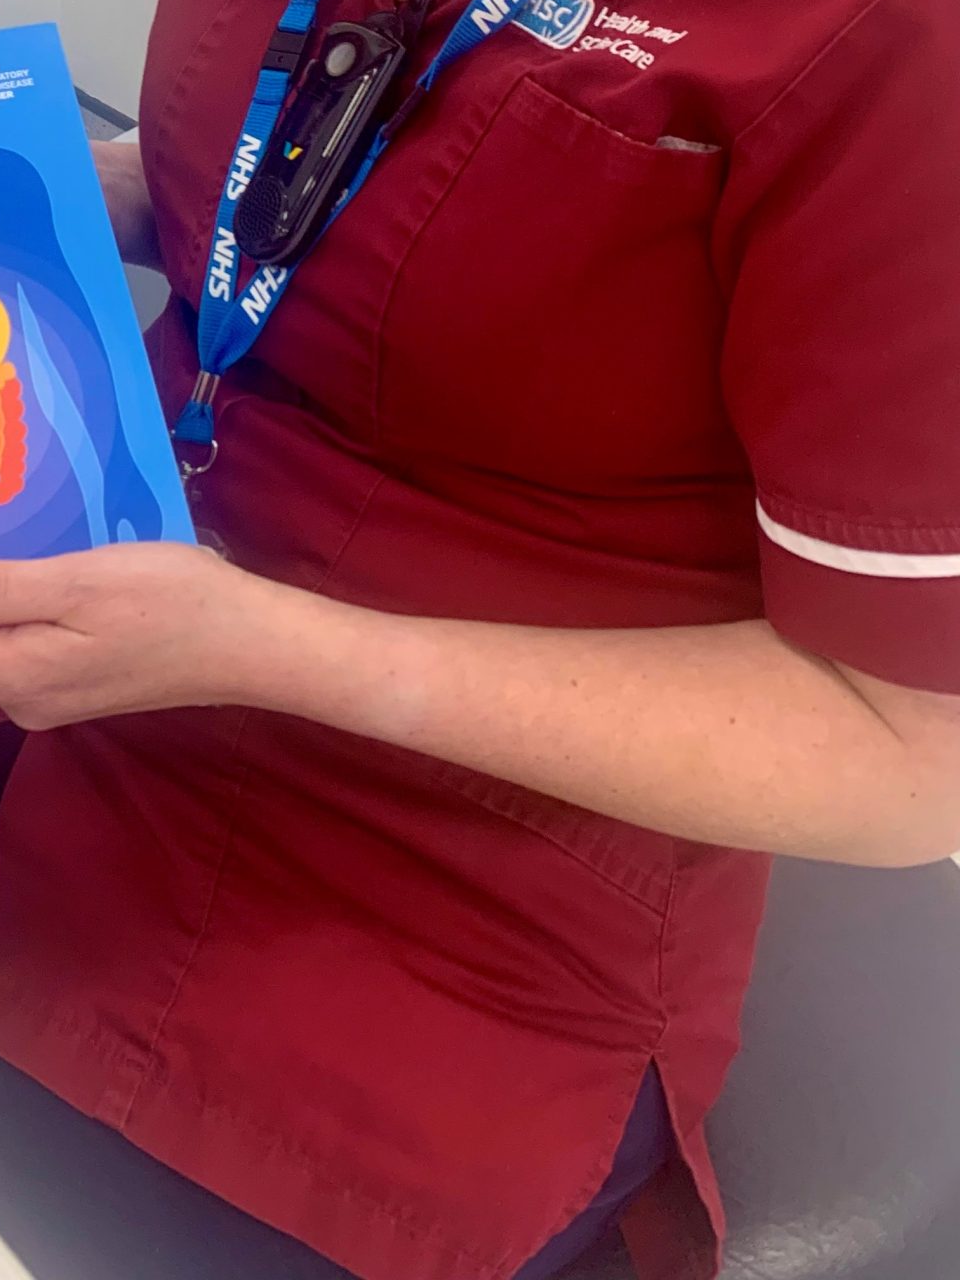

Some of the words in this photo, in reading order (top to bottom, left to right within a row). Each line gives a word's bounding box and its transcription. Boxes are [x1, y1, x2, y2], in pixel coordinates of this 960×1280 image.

[593, 6, 650, 36] Health
[609, 40, 655, 70] Care
[226, 133, 262, 201] NHS
[208, 226, 237, 303] NHS
